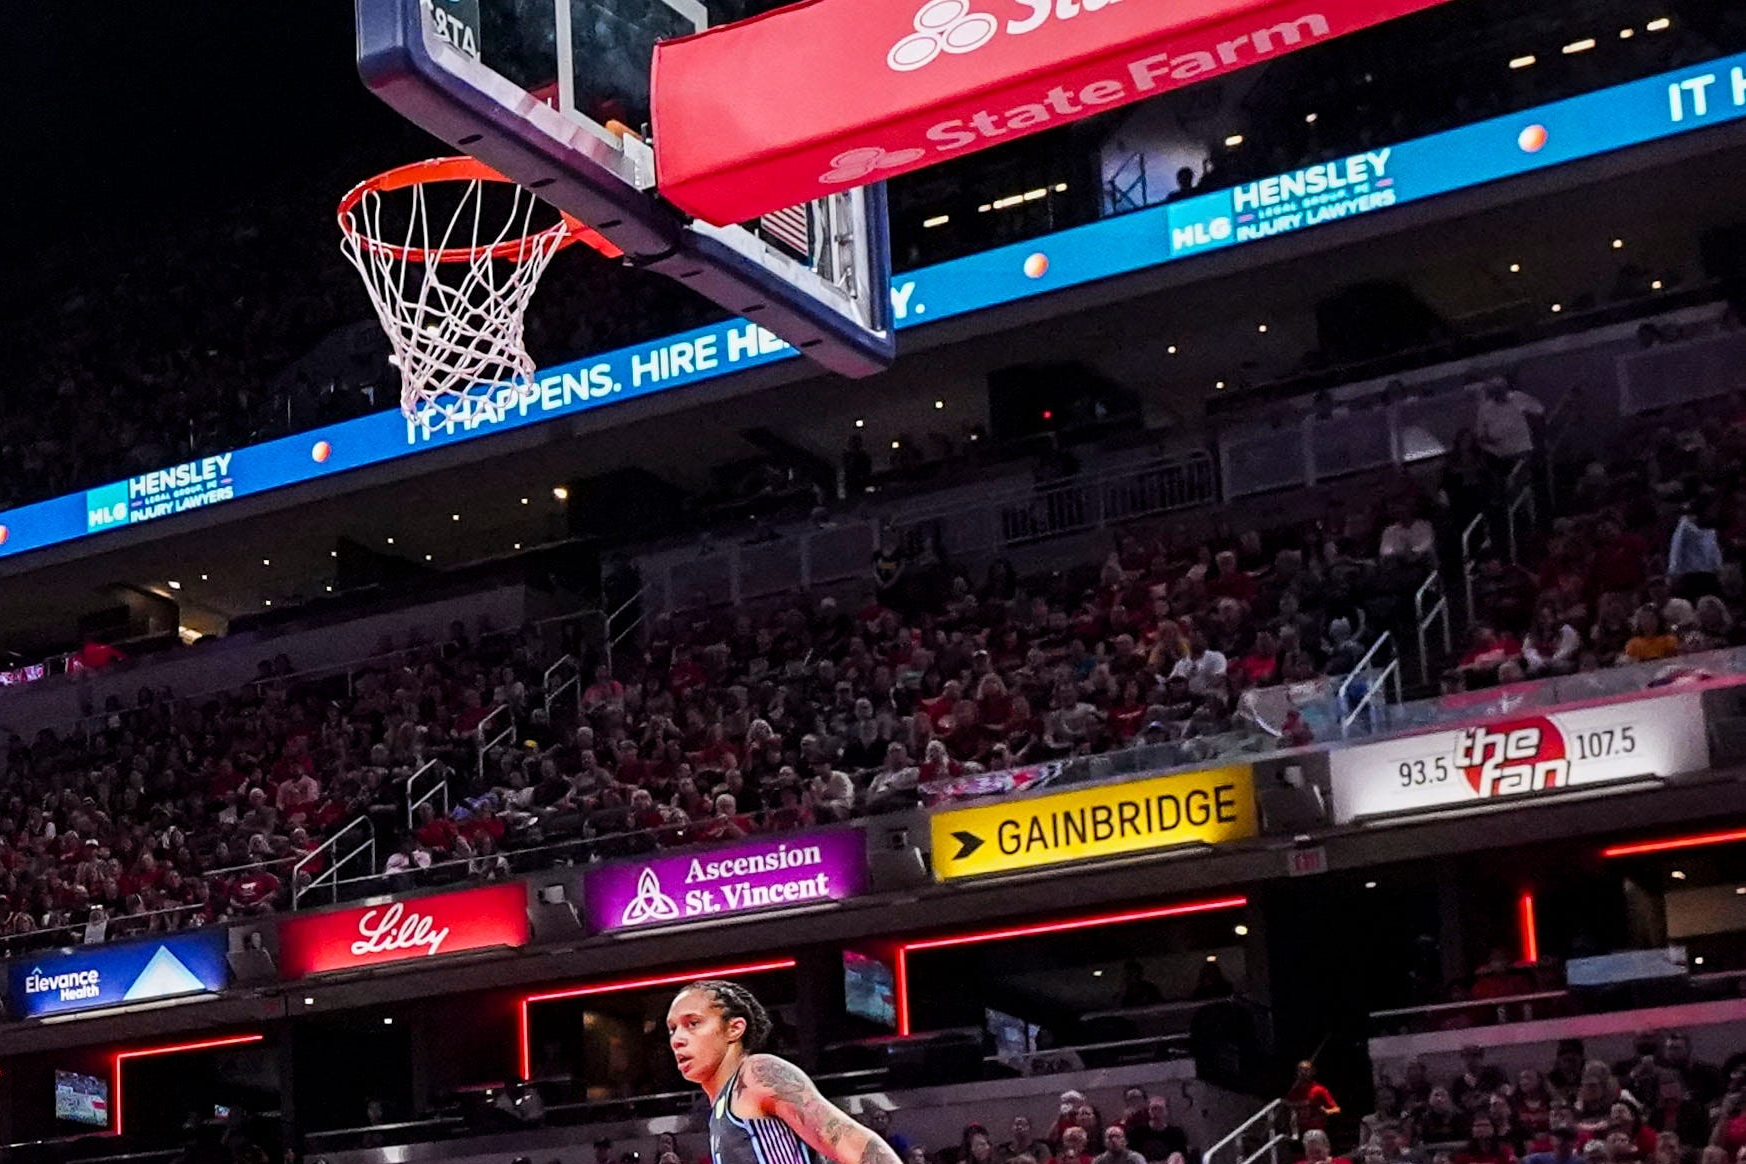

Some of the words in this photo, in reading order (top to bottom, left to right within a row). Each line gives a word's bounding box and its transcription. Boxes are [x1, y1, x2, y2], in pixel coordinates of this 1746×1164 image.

[926, 78, 1125, 152] State
[1127, 13, 1331, 92] Farm
[1668, 73, 1716, 122] IT
[1233, 148, 1391, 212] HENSLEY
[1172, 217, 1231, 250] HLG
[1236, 212, 1303, 242] INJURY
[1307, 188, 1396, 226] LAWYERS
[445, 364, 621, 436] HAPPENS.
[631, 335, 719, 386] HIRE
[129, 452, 232, 499] HENSLEY
[88, 502, 128, 527] HLG
[130, 501, 173, 523] INJURY
[175, 485, 235, 513] LAWYERS
[1399, 757, 1448, 788] 93.5
[1455, 727, 1542, 768] the
[1576, 726, 1636, 761] 107.5
[1479, 757, 1571, 798] fan
[997, 784, 1238, 858] GAINBRIDGE
[684, 842, 822, 884] Ascension
[685, 889, 723, 916] St.
[724, 871, 830, 911] Vincent
[352, 902, 450, 957] Lilly
[25, 966, 99, 994] Elevance
[59, 984, 100, 1002] Health
